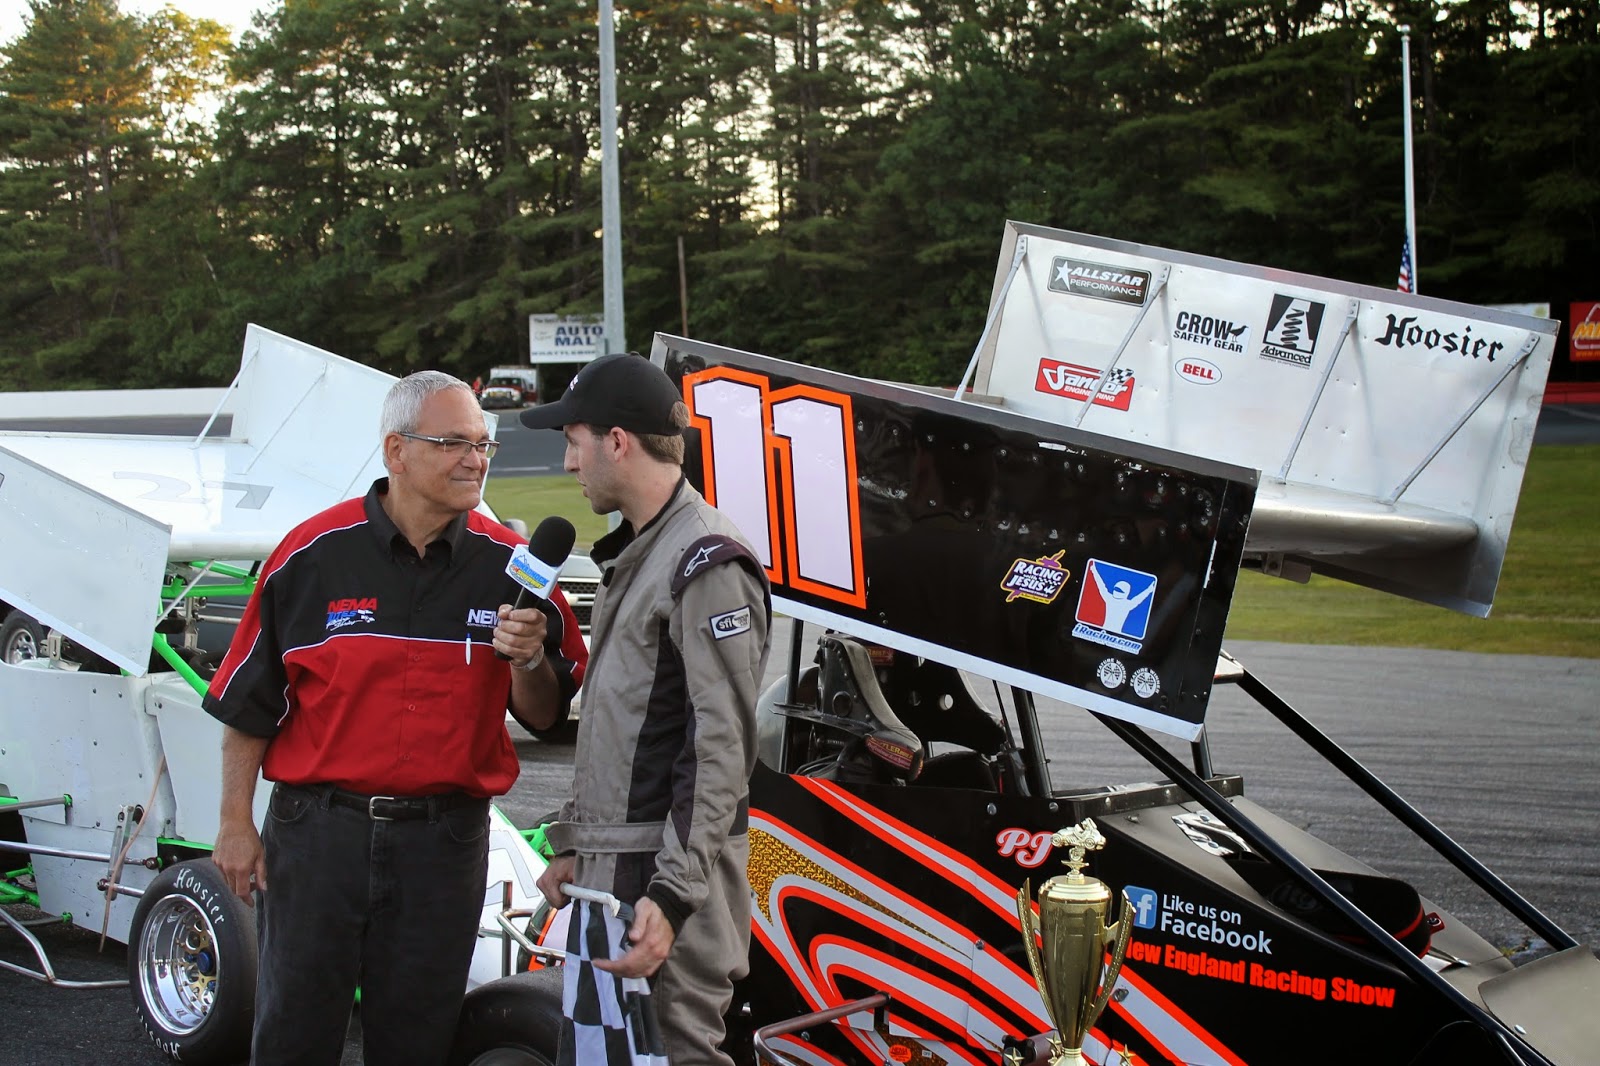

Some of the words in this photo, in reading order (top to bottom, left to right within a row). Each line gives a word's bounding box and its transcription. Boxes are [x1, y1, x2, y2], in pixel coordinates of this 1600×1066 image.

[1070, 267, 1144, 286] ALLSTAR
[1070, 278, 1142, 297] PERFORMANCE
[556, 325, 603, 336] AUTO
[1176, 311, 1233, 340] CROW
[1173, 330, 1212, 346] SAFETY
[1214, 339, 1243, 353] GEAR
[1374, 313, 1504, 362] Hoosier
[1261, 346, 1312, 363] Advanced
[1183, 363, 1214, 380] BELL
[1063, 385, 1115, 402] ENGINERING
[683, 366, 867, 609] 11
[1014, 561, 1063, 581] RACING
[1006, 575, 1046, 591] JESUS
[327, 597, 377, 612] NEMA
[1074, 624, 1142, 650] iRacing.com
[1097, 658, 1115, 677] FEATURE
[1130, 667, 1149, 687] FEATURE
[996, 828, 1053, 868] PJ
[173, 868, 224, 924] Hoosier
[1163, 894, 1194, 915] Like
[1199, 905, 1217, 919] us
[1220, 909, 1241, 925] on
[1161, 911, 1272, 955] Facebook
[1164, 944, 1246, 983] England
[1250, 962, 1326, 1001] Racing
[1331, 977, 1396, 1008] Show
